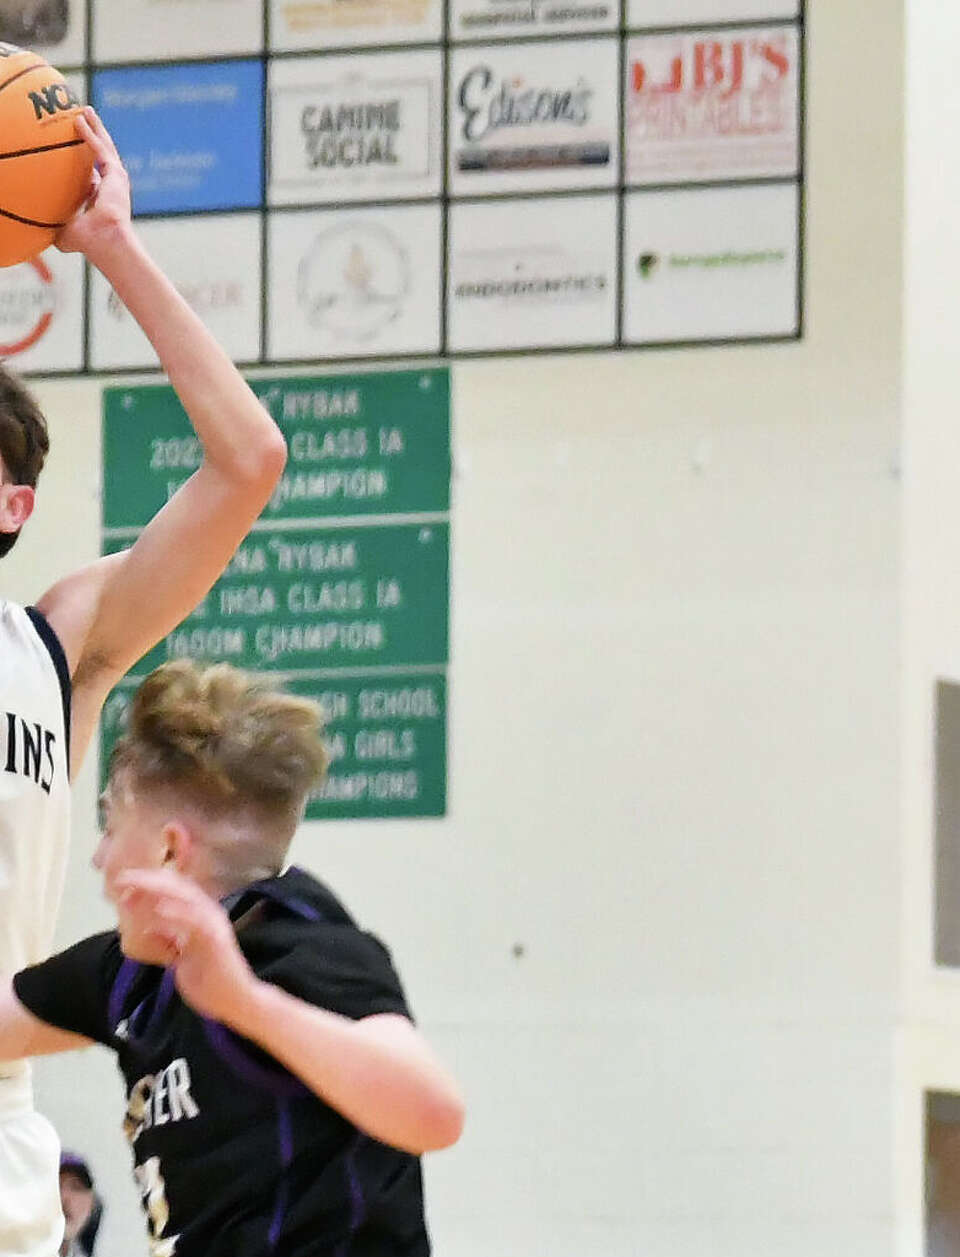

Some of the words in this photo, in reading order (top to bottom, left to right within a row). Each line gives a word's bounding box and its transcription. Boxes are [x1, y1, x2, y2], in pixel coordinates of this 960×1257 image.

[290, 429, 368, 461] CLASS
[278, 469, 386, 502] HAMPION
[287, 579, 364, 613] CLASS
